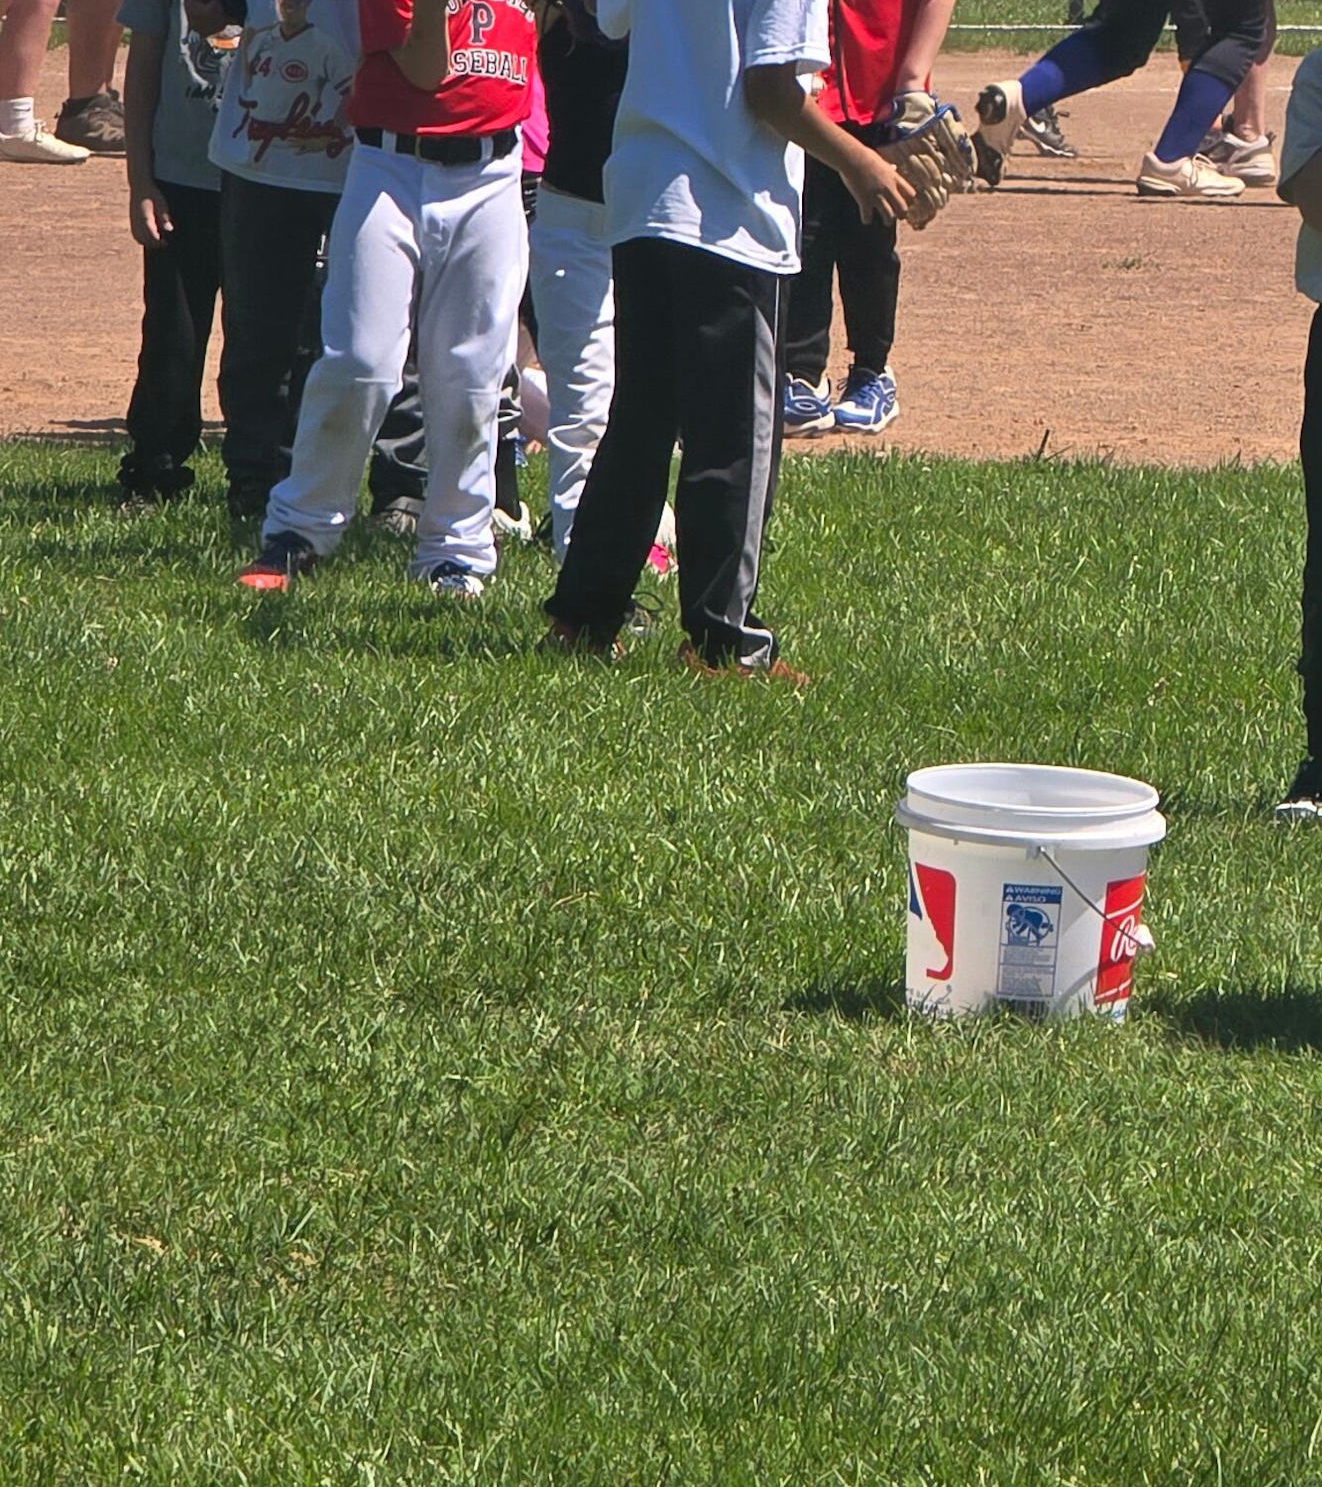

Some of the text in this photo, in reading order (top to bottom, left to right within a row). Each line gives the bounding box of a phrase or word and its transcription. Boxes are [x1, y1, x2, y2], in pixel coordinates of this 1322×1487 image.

[470, 1, 496, 45] P
[450, 50, 528, 86] SEBALL
[1014, 885, 1061, 895] WARNING
